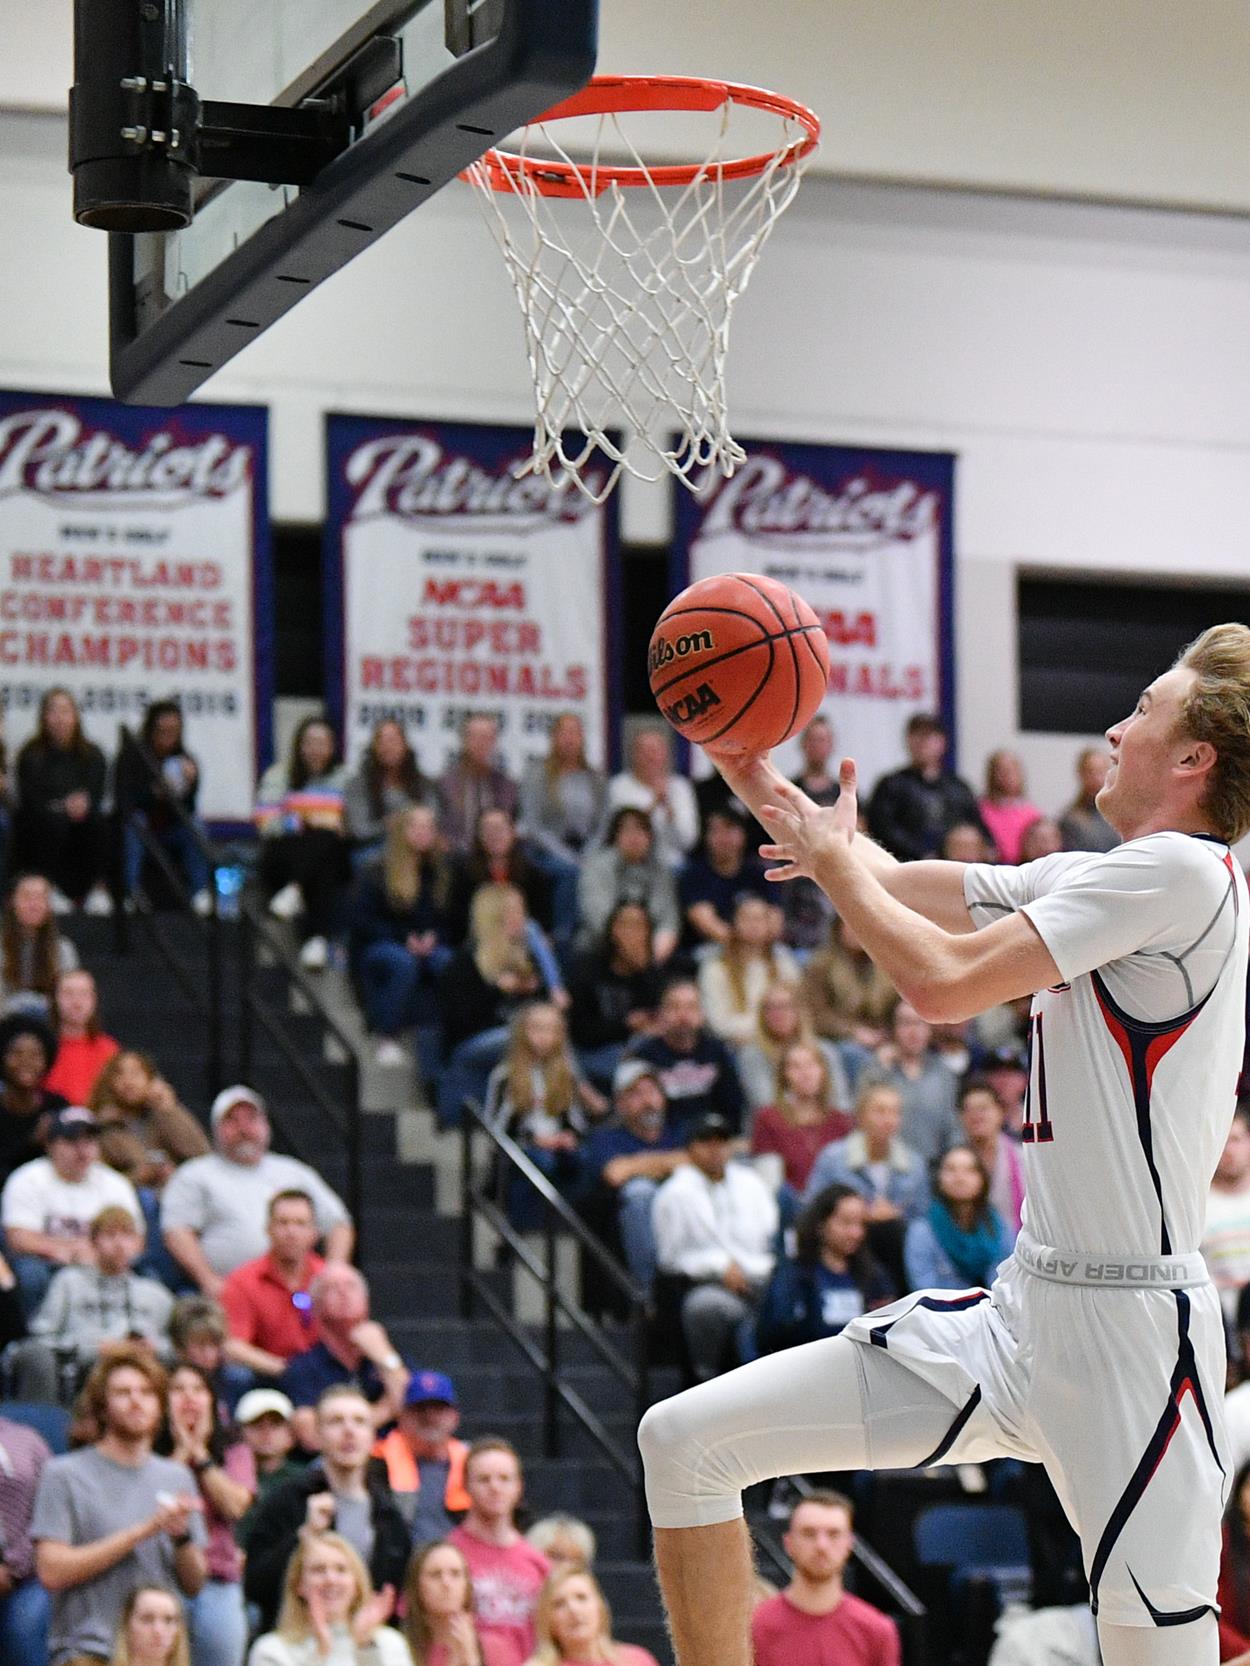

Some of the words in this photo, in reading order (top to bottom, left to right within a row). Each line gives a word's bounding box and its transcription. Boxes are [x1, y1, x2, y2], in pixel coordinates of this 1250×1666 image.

[0, 409, 252, 496] Patriots
[10, 553, 222, 590] HEARTLAND
[0, 590, 233, 630] CONFERENCE
[0, 630, 238, 673] CHAMPIONS
[408, 615, 542, 656] SUPER
[649, 628, 714, 671] ilson
[360, 656, 588, 701] REGIONALS
[1085, 1263, 1188, 1281] UNDER
